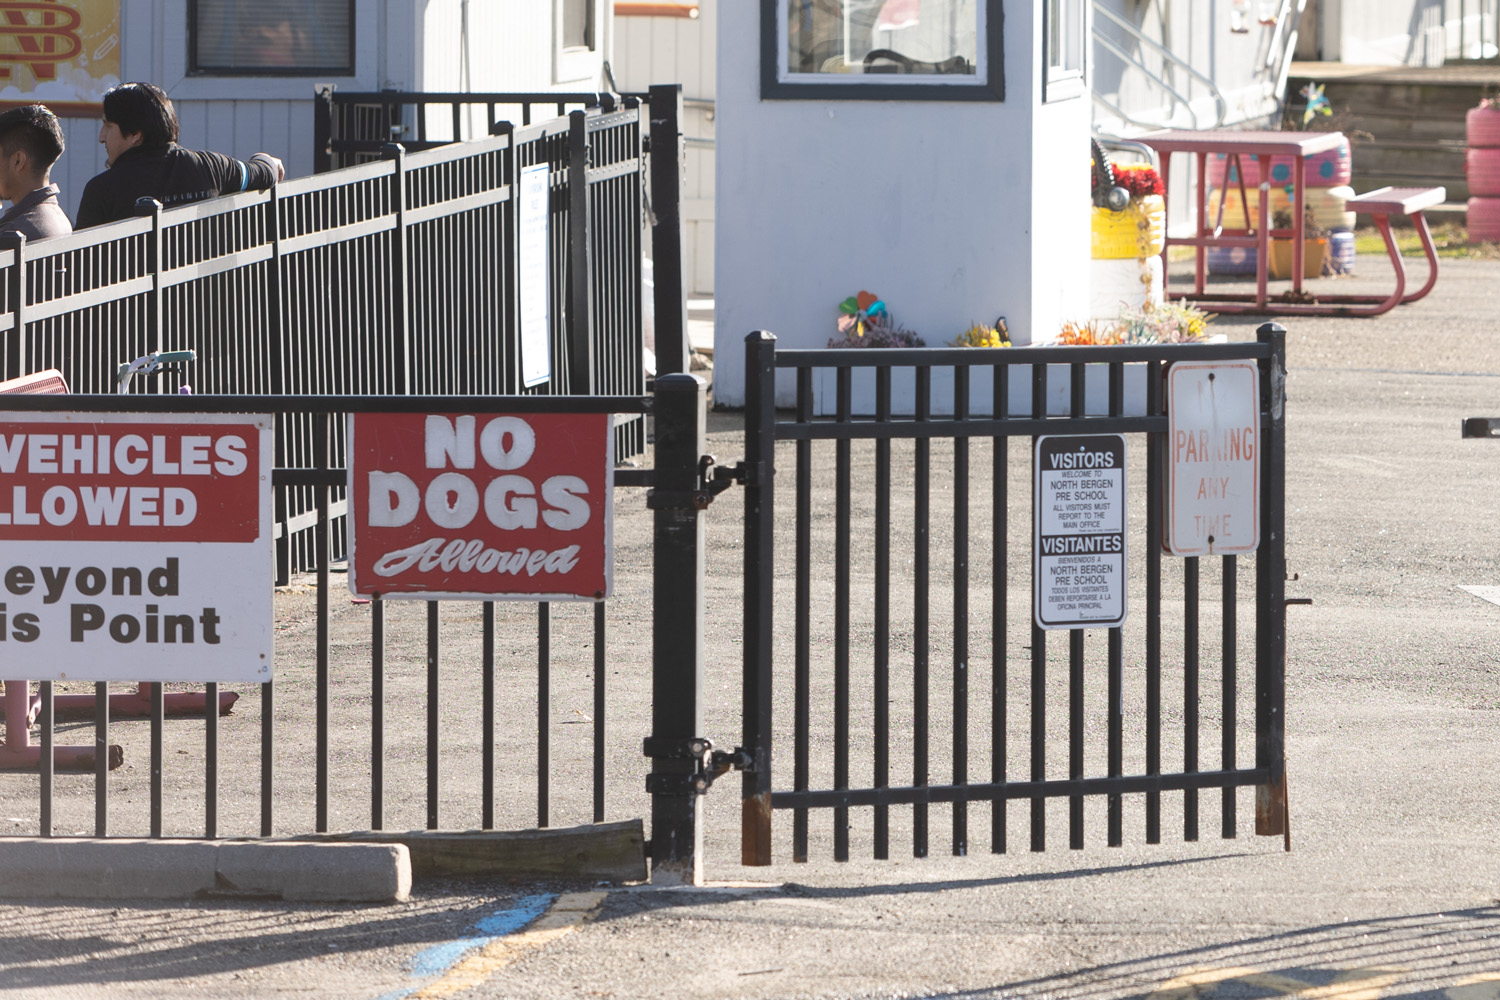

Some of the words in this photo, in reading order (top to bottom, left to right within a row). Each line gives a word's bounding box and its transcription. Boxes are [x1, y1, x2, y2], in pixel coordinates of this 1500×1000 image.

[424, 414, 536, 471] NO
[1176, 426, 1253, 463] PARING
[0, 434, 248, 476] VEHICLES
[1050, 451, 1115, 469] VISITORS
[1061, 470, 1092, 478] WELCOME
[1094, 470, 1102, 478] TO
[1050, 480, 1078, 490] NORTH
[1081, 479, 1113, 489] BERGEN
[1197, 477, 1229, 500] ANY
[368, 470, 591, 531] DOGS
[1056, 491, 1071, 501] PRE
[1074, 491, 1108, 501] SCHOOL
[0, 485, 198, 527] LOWED
[1053, 504, 1064, 512] ALL
[1065, 503, 1092, 511] VISITORS
[1094, 502, 1111, 510] MUST
[1058, 512, 1081, 520] REPORT
[1084, 512, 1092, 520] TO
[1094, 511, 1105, 519] THE
[1063, 521, 1078, 529] MAIN
[1080, 520, 1101, 528] OFFICE
[1194, 514, 1232, 537] TIME
[1042, 535, 1122, 554] VISITANTES
[373, 537, 581, 577] Allowed
[1058, 556, 1096, 564] BIENVENIDOS
[1050, 566, 1078, 575] NORTH
[1080, 565, 1113, 574] BERGEN
[4, 557, 179, 604] eyond
[1055, 576, 1071, 586] PRE
[1074, 575, 1107, 585] SCHOOL
[1069, 586, 1080, 594] LOS
[1081, 585, 1109, 593] VISITANTES
[1066, 594, 1098, 602] REPORTARSE
[70, 603, 221, 644] Point
